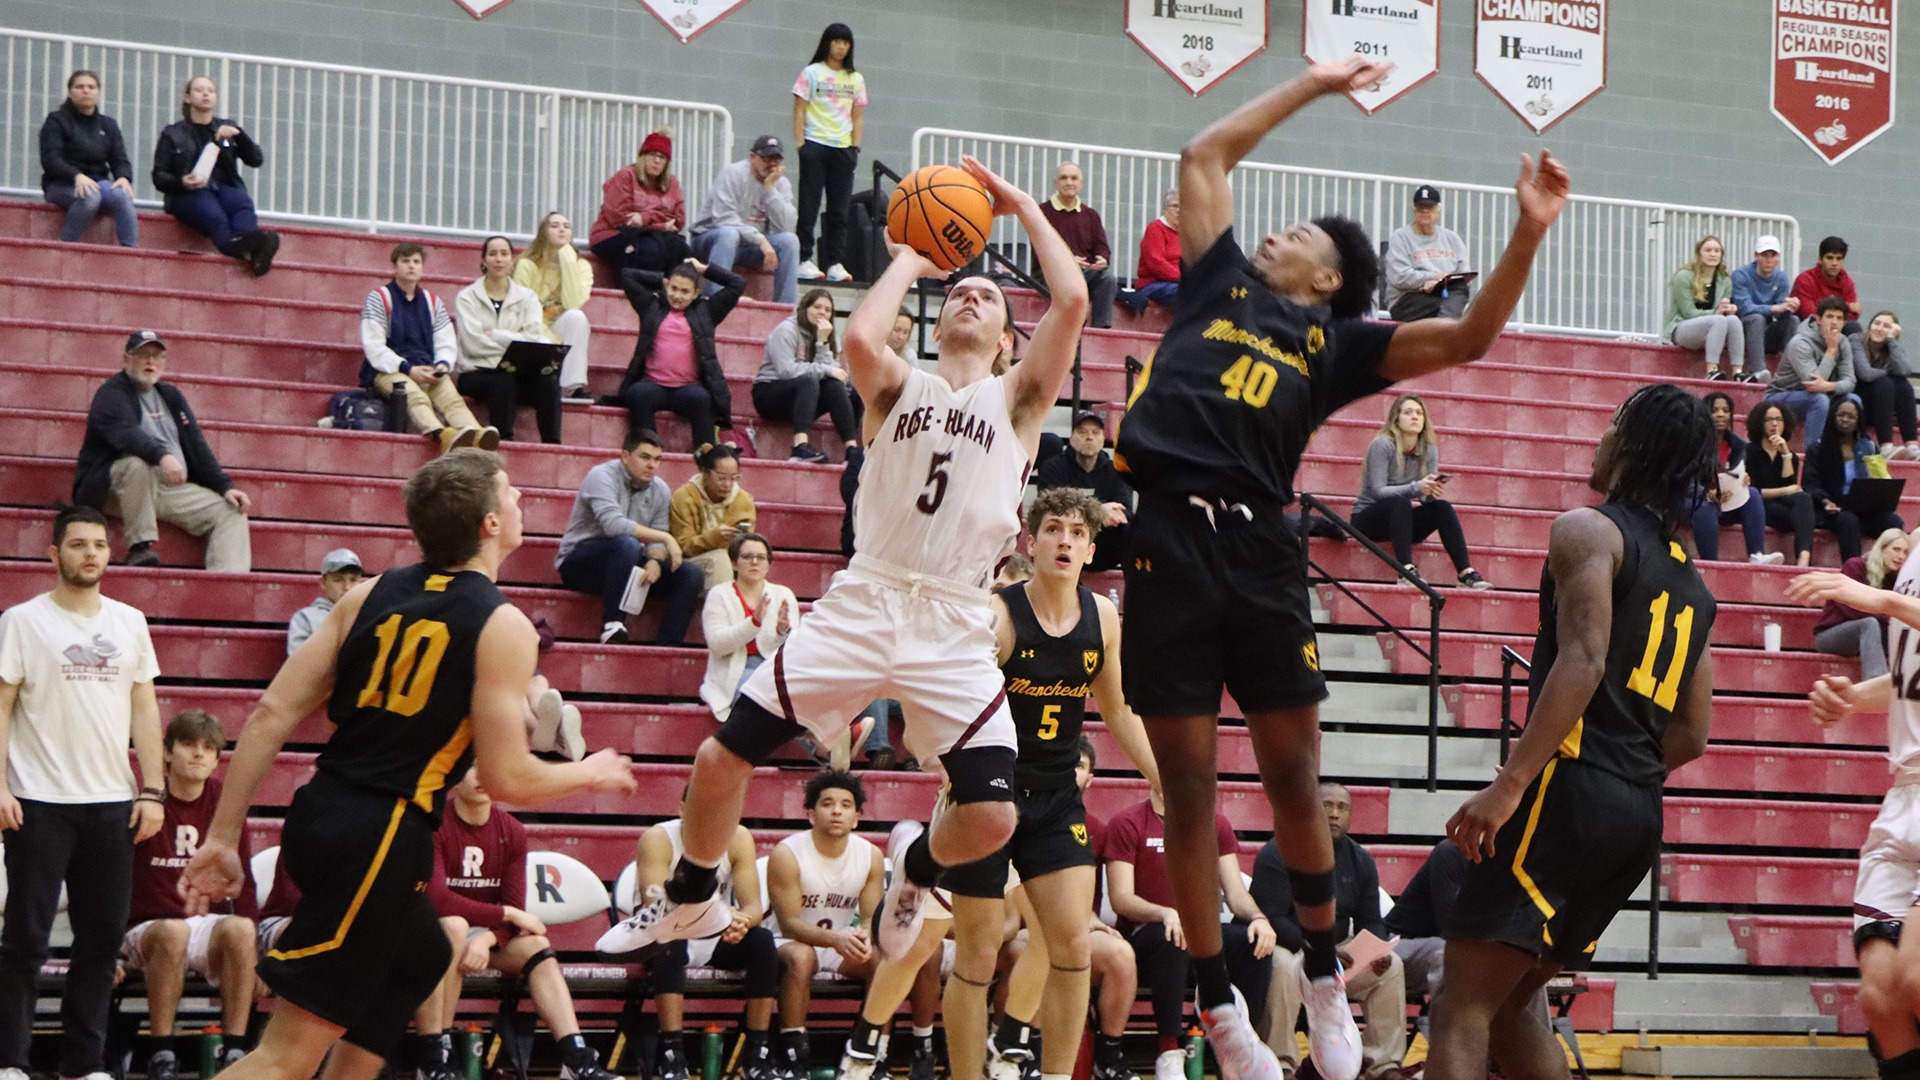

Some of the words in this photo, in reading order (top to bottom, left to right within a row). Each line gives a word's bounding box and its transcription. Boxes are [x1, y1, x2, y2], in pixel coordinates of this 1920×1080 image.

[1152, 0, 1243, 19] Heartland
[1331, 0, 1418, 20] Heartland
[1483, 0, 1599, 29] CHAMPIONS
[1779, 0, 1890, 25] BASKETBALL
[1182, 34, 1214, 50] 2018
[1782, 21, 1837, 37] REGULAR
[1841, 28, 1887, 43] SEASON
[1353, 41, 1388, 56] 2011
[1499, 35, 1583, 60] Heartland
[1782, 34, 1887, 64] CHAMPIONS
[1526, 74, 1553, 90] 2011
[1795, 60, 1875, 83] Heartland
[1815, 94, 1850, 111] 2016
[1220, 354, 1279, 409] 40
[916, 451, 953, 516] 5
[1626, 590, 1694, 713] 11
[356, 613, 451, 717] 10
[1007, 677, 1090, 698] Manchest
[1037, 705, 1061, 740] 5
[176, 825, 199, 857] R
[463, 846, 485, 877] R
[446, 877, 501, 888] ASKETBALL
